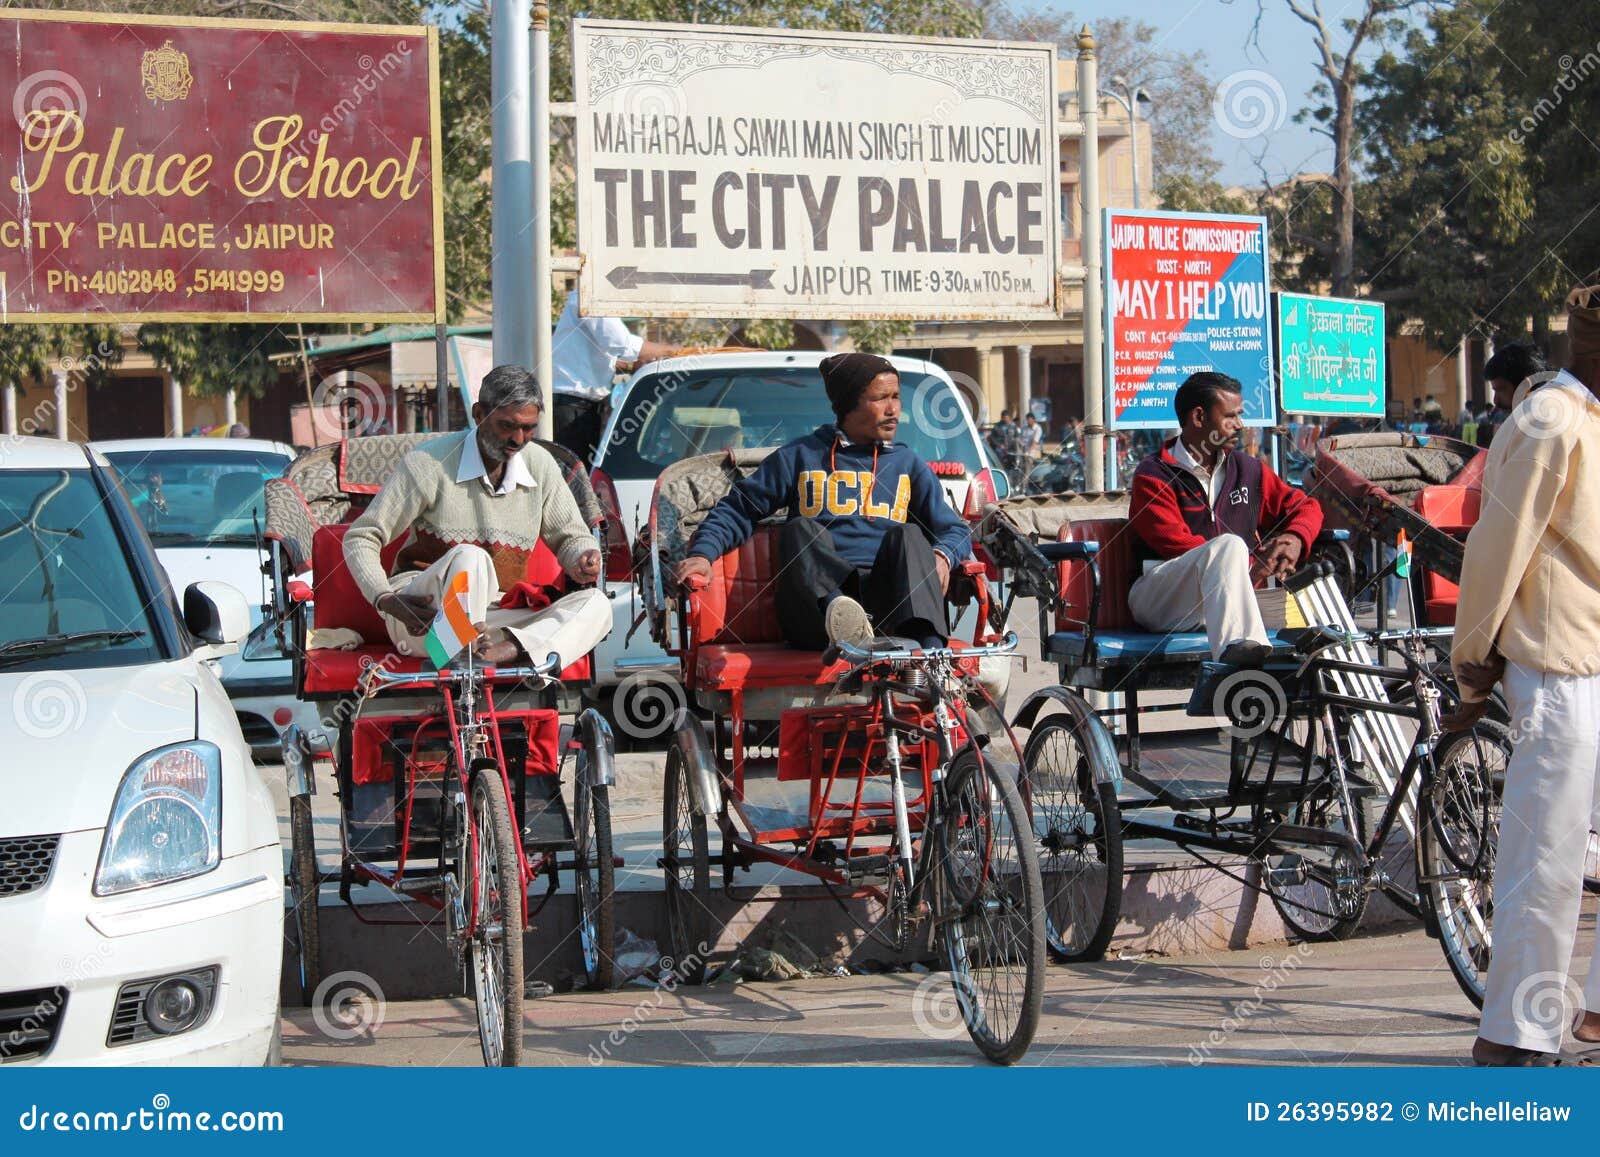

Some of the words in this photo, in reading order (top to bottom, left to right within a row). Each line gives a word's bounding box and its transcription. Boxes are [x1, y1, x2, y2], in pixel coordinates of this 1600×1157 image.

[10, 110, 214, 198] Palace
[234, 114, 423, 201] School
[593, 111, 728, 157] MAHARAJA
[734, 116, 798, 159] SAWAI
[803, 119, 853, 160] MAN
[859, 121, 923, 162] SINGH
[929, 124, 945, 163] II
[949, 125, 1042, 165] MUSEUM
[594, 168, 698, 249] THE
[712, 170, 841, 252] CITY
[857, 176, 1044, 256] PALACE
[0, 221, 75, 249] CITY
[1112, 223, 1145, 250] JAIPUR
[1149, 225, 1180, 252] POLICE
[784, 265, 873, 297] JAIPUR
[1184, 260, 1212, 275] NORTH
[1112, 279, 1160, 321] MAY
[1165, 280, 1176, 320] I
[1179, 280, 1226, 321] HELP
[1228, 281, 1265, 320] YOU
[1210, 341, 1234, 351] MANAK
[798, 470, 912, 524] UCLA
